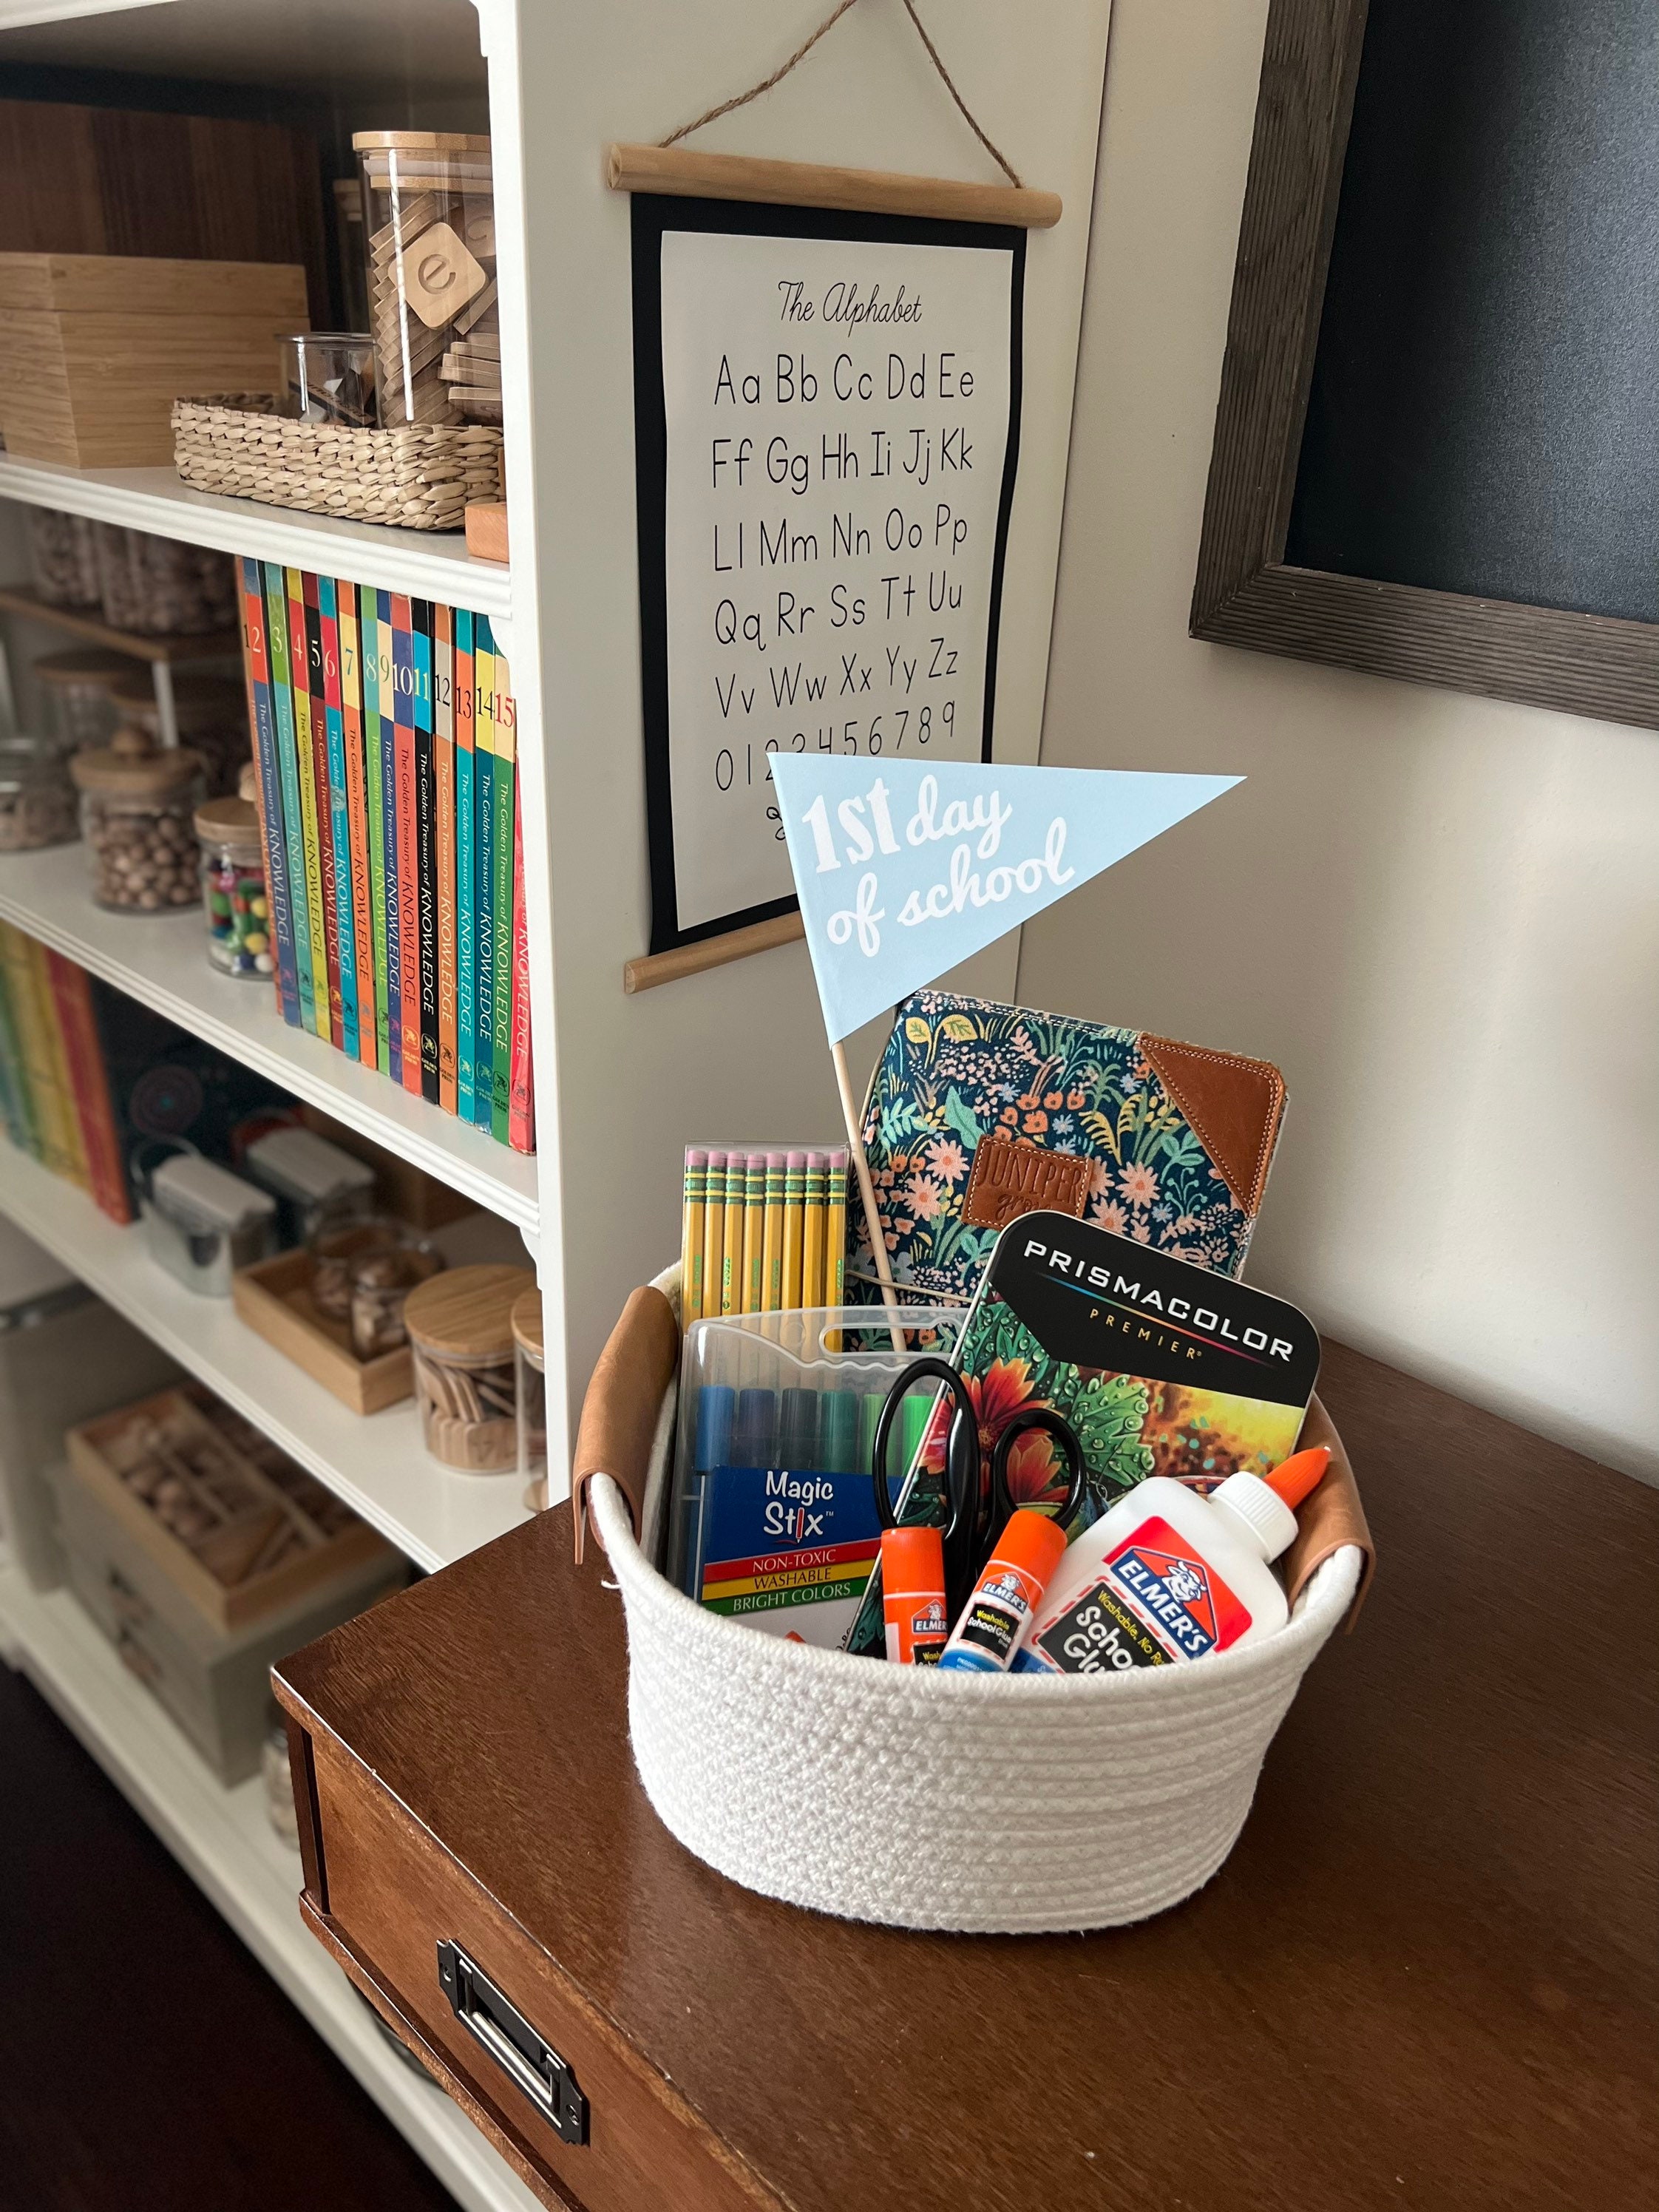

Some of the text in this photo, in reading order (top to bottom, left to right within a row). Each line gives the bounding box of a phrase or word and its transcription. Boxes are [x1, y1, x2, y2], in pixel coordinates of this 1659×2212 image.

[418, 254, 456, 295] e
[778, 280, 923, 337] The Alphabet
[714, 353, 974, 404] Aa Bb Cc Dd Ee
[713, 427, 973, 495] Ff Gg Hh Ii Jj Kk
[714, 503, 968, 571] Ll Mm Nn Oo Pp
[714, 570, 962, 651] Qq Rr Ss Tt Uu
[252, 626, 261, 653] 2
[272, 626, 282, 653] 3
[294, 634, 303, 661] 4
[311, 639, 321, 668] 5
[325, 650, 336, 677] 6
[345, 648, 353, 676] 7
[366, 654, 376, 682] 8
[380, 654, 390, 682] 9
[393, 663, 413, 696] 10
[715, 638, 958, 718] Vv Ww Xx Yy Zz
[414, 668, 429, 702] 11
[435, 674, 450, 707] 12
[456, 686, 472, 719] 13
[476, 686, 495, 720] 14
[495, 693, 515, 727] 15
[384, 764, 393, 805] Golden
[501, 784, 509, 805] The
[906, 775, 1013, 860] day
[355, 844, 362, 858] of
[402, 818, 410, 862] Treasury
[441, 832, 449, 880] Treasury
[389, 857, 396, 869] of
[404, 866, 412, 881] of
[423, 872, 430, 887] of
[481, 847, 490, 895] Treasury
[498, 855, 508, 906] Treasury
[307, 838, 322, 958] KNOWLEDGE
[444, 882, 450, 895] of
[463, 895, 469, 907] of
[827, 816, 1075, 957] of school
[323, 847, 339, 966] KNOWLEDGE
[354, 858, 370, 981] KNOWLEDGE
[483, 898, 490, 912] of
[500, 907, 507, 921] of
[387, 872, 400, 996] KNOWLEDGE
[402, 881, 415, 1006] KNOWLEDGE
[421, 887, 434, 1015] KNOWLEDGE
[441, 896, 452, 1025] KNOWLEDGE
[461, 908, 472, 1037] KNOWLEDGE
[480, 912, 492, 1042] KNOWLEDGE
[497, 921, 509, 1053] KNOWLEDGE
[517, 928, 529, 1058] KNOWLEDGE
[975, 1143, 1084, 1205] JUNIPER
[1024, 1240, 1293, 1362] PRISMACOLOR
[765, 1470, 834, 1507] Magic
[753, 1549, 836, 1573] NON-TOXIC
[754, 1567, 832, 1590] WASHABLE
[733, 1582, 851, 1612] BRIGHT COLORS
[983, 1583, 1026, 1611] ELMER'S
[1118, 1559, 1208, 1652] ELMER'S
[967, 1617, 996, 1635] School
[977, 1609, 1010, 1632] Washable
[1076, 1606, 1141, 1669] Scho
[1138, 1637, 1153, 1654] No
